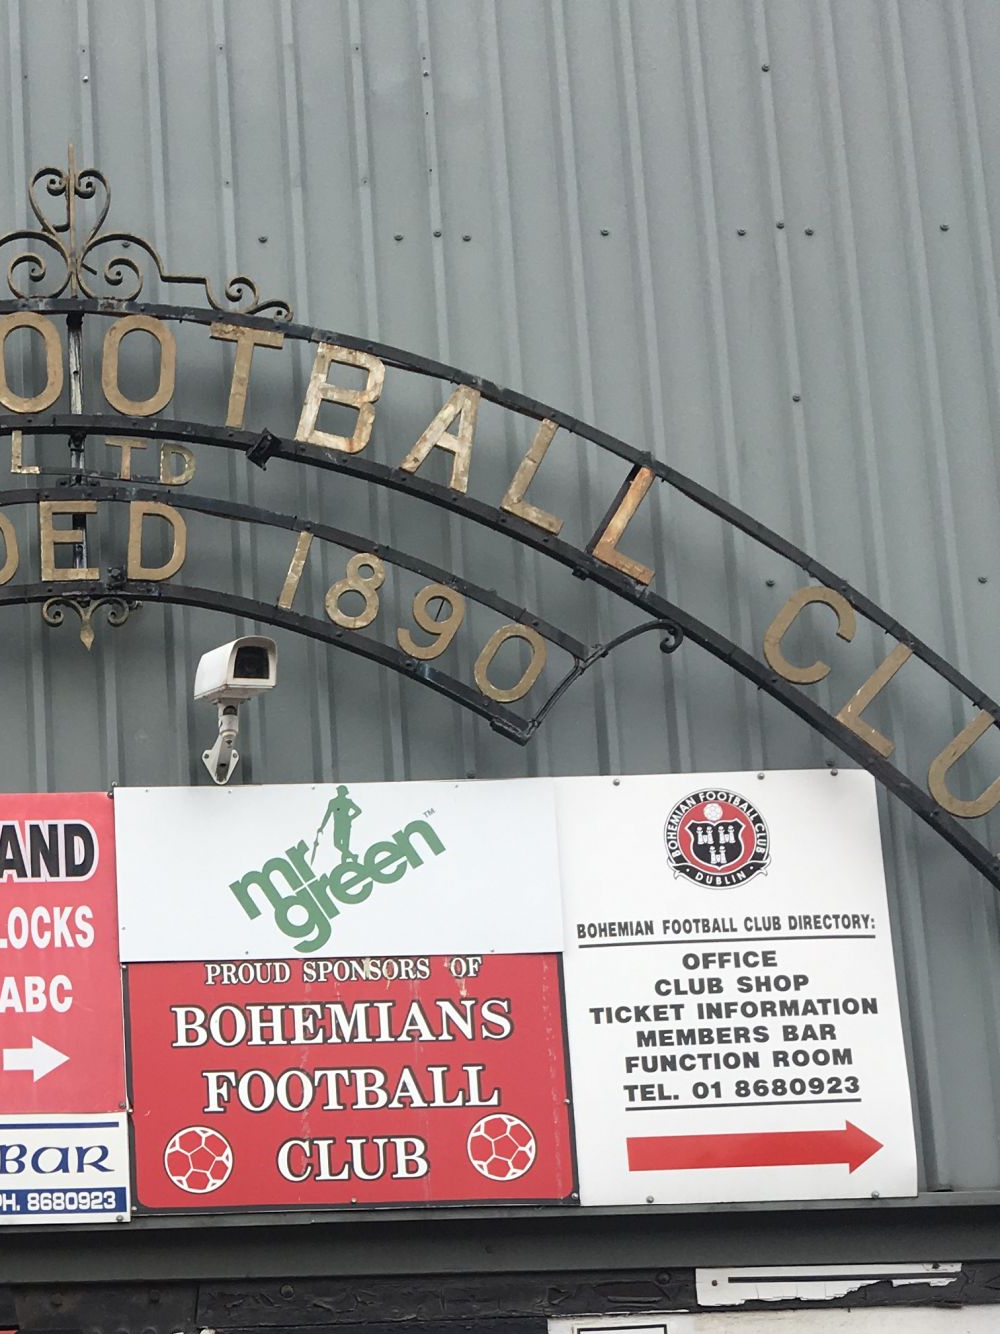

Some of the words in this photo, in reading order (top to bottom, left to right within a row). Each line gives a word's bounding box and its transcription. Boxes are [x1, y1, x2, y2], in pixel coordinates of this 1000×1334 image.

[11, 430, 196, 486] LTD
[278, 530, 547, 702] 1890
[667, 795, 696, 858] BOHEMIAN
[698, 791, 758, 821] FOOTBALL
[755, 822, 767, 854] CLUB
[274, 817, 446, 953] green
[695, 871, 746, 886] DUBLIN
[577, 920, 654, 938] BOHEMIAN
[662, 918, 737, 935] FOOTBALL
[744, 916, 781, 932] CLUB
[788, 914, 876, 931] DIRECTORY:
[204, 961, 290, 985] PROUD
[302, 958, 430, 984] SPONSORS
[449, 956, 483, 979] OF
[682, 950, 778, 970] OFFICE
[654, 977, 724, 996] CLUB
[737, 974, 810, 992] SHOP
[171, 997, 513, 1049] BOHEMIANS
[589, 1003, 685, 1024] TICKET
[698, 997, 879, 1019] INFORMATION
[636, 1025, 770, 1047] MEMBERS
[783, 1023, 837, 1041] BAR
[625, 1052, 760, 1073] FUNCTION
[773, 1048, 853, 1067] ROOM
[202, 1065, 500, 1114] FOOTBALL
[624, 1082, 679, 1101] TEL.
[692, 1080, 722, 1098] 01
[735, 1076, 860, 1097] 8680923
[276, 1136, 430, 1182] CLUB
[27, 1190, 116, 1211] 8680923
